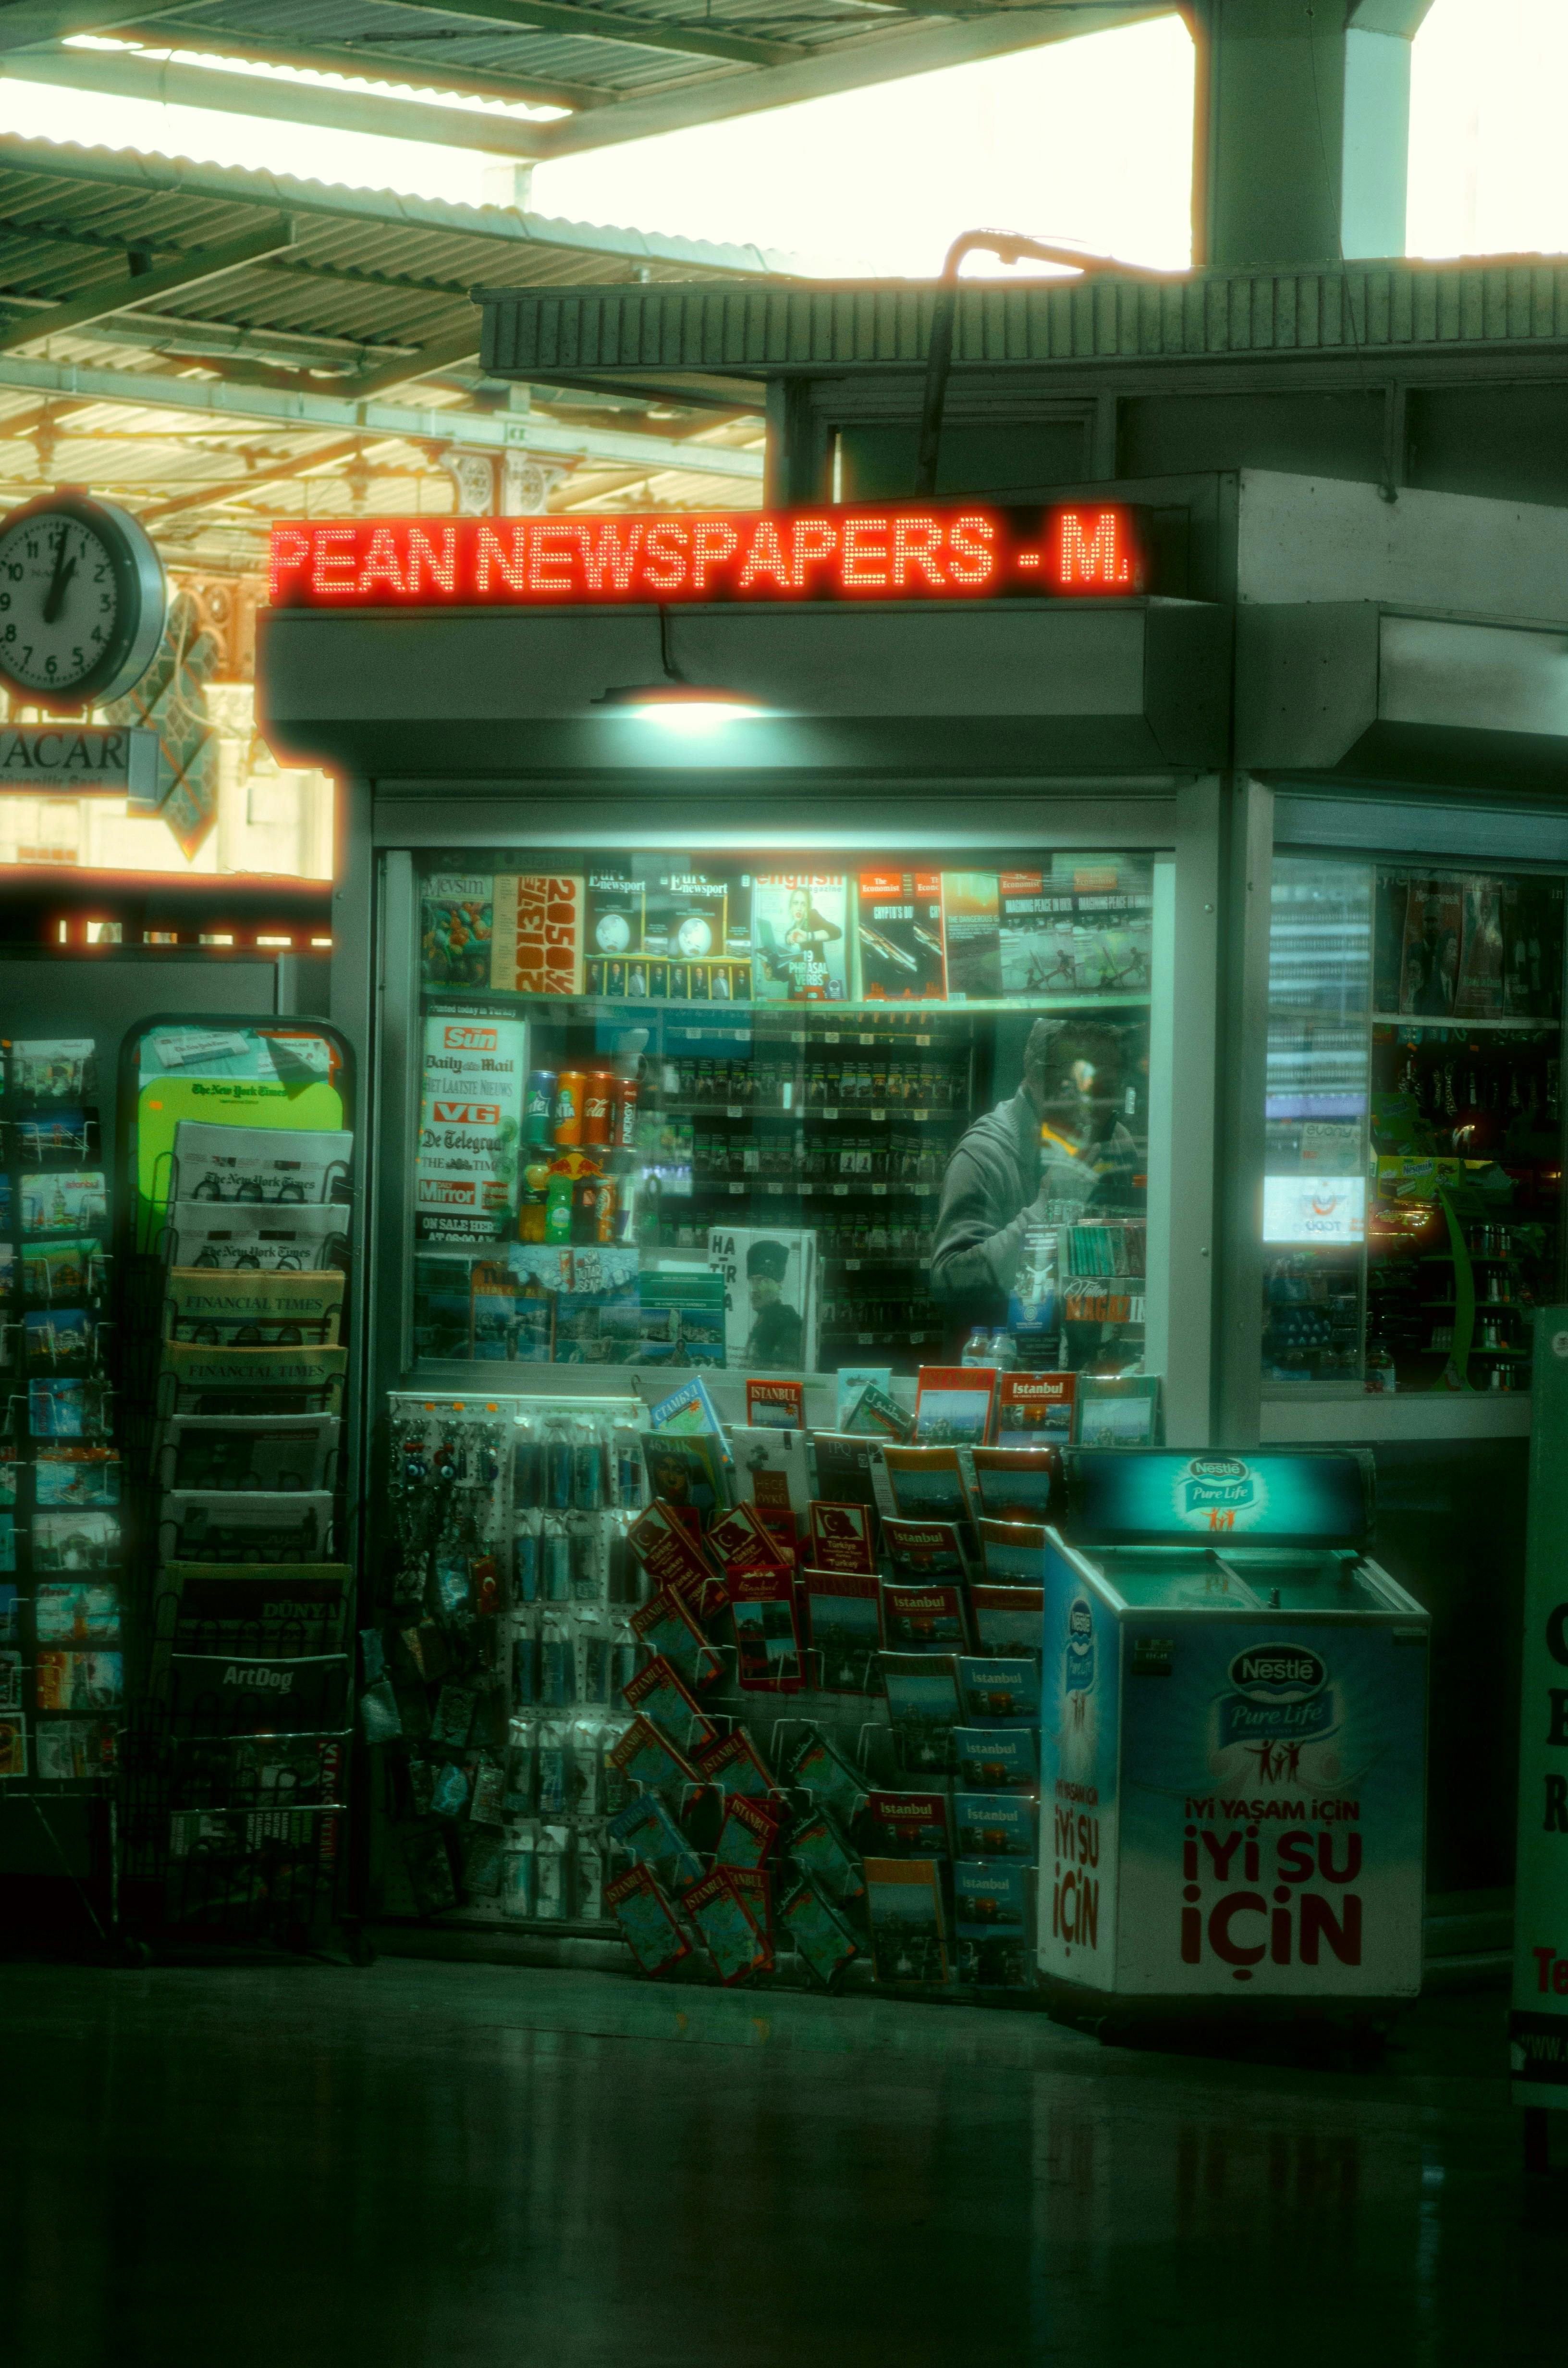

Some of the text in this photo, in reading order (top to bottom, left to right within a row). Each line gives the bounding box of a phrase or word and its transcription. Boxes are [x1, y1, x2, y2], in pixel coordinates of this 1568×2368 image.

[269, 527, 455, 594] PEAN
[476, 515, 994, 592] NEWSPAPERS
[0, 731, 126, 769] ACAR
[862, 885, 900, 893] Economist
[803, 950, 814, 962] 19
[789, 962, 829, 974] PHRASAL
[795, 974, 823, 986] VERBS
[446, 1027, 496, 1049] Sun
[426, 1055, 514, 1074] Daily Mail
[192, 1084, 288, 1098] The New York Times
[437, 1103, 495, 1123] VG
[622, 1101, 634, 1144] ENERGY
[1306, 1125, 1353, 1137] evony
[422, 1128, 441, 1148] De
[422, 1157, 444, 1169] THE
[1402, 1161, 1433, 1176] Nesquik
[206, 1172, 315, 1189] The New York Times
[420, 1181, 475, 1203] Mirror
[422, 1217, 438, 1230] ON
[439, 1218, 468, 1231] SALE
[223, 1246, 248, 1257] New
[249, 1246, 276, 1258] York
[277, 1246, 311, 1258] Times
[185, 1296, 323, 1310] FINANCIAL TIMES
[189, 1366, 325, 1377] FINANCIAL TIMES
[750, 1386, 798, 1401] ISTANBUL
[1013, 1381, 1064, 1394] Istanbul
[654, 1383, 698, 1421] СТАМБУЛ
[826, 1442, 852, 1457] TPQ
[1194, 1461, 1240, 1476] Nestlé
[755, 1479, 784, 1490] HECE
[1192, 1485, 1248, 1501] Pure Life
[826, 1539, 856, 1550] Türkiye
[893, 1529, 943, 1543] Istanbul
[661, 1555, 684, 1577] Turkey
[826, 1558, 859, 1569] Turkey
[265, 1599, 337, 1618] DÜNYA
[893, 1595, 946, 1612] Istanbul
[634, 1597, 671, 1630] ISTANBUL
[1241, 1657, 1314, 1681] Nestlé
[222, 1665, 295, 1695] ArtDog
[625, 1665, 665, 1702] ISTANBUL
[1230, 1702, 1326, 1728] Pure Life
[613, 1721, 648, 1761] ISTANBUL
[703, 1738, 743, 1773] ISTANBUL
[730, 1798, 769, 1838] ISTANBUL
[879, 1801, 933, 1817] Istanbul
[1220, 1800, 1305, 1825] YAŞAM
[1078, 1814, 1099, 1868] SU
[1276, 1830, 1362, 1884] SU
[606, 1869, 646, 1901] ISTANBUL
[686, 1876, 725, 1910] ISTANBUL
